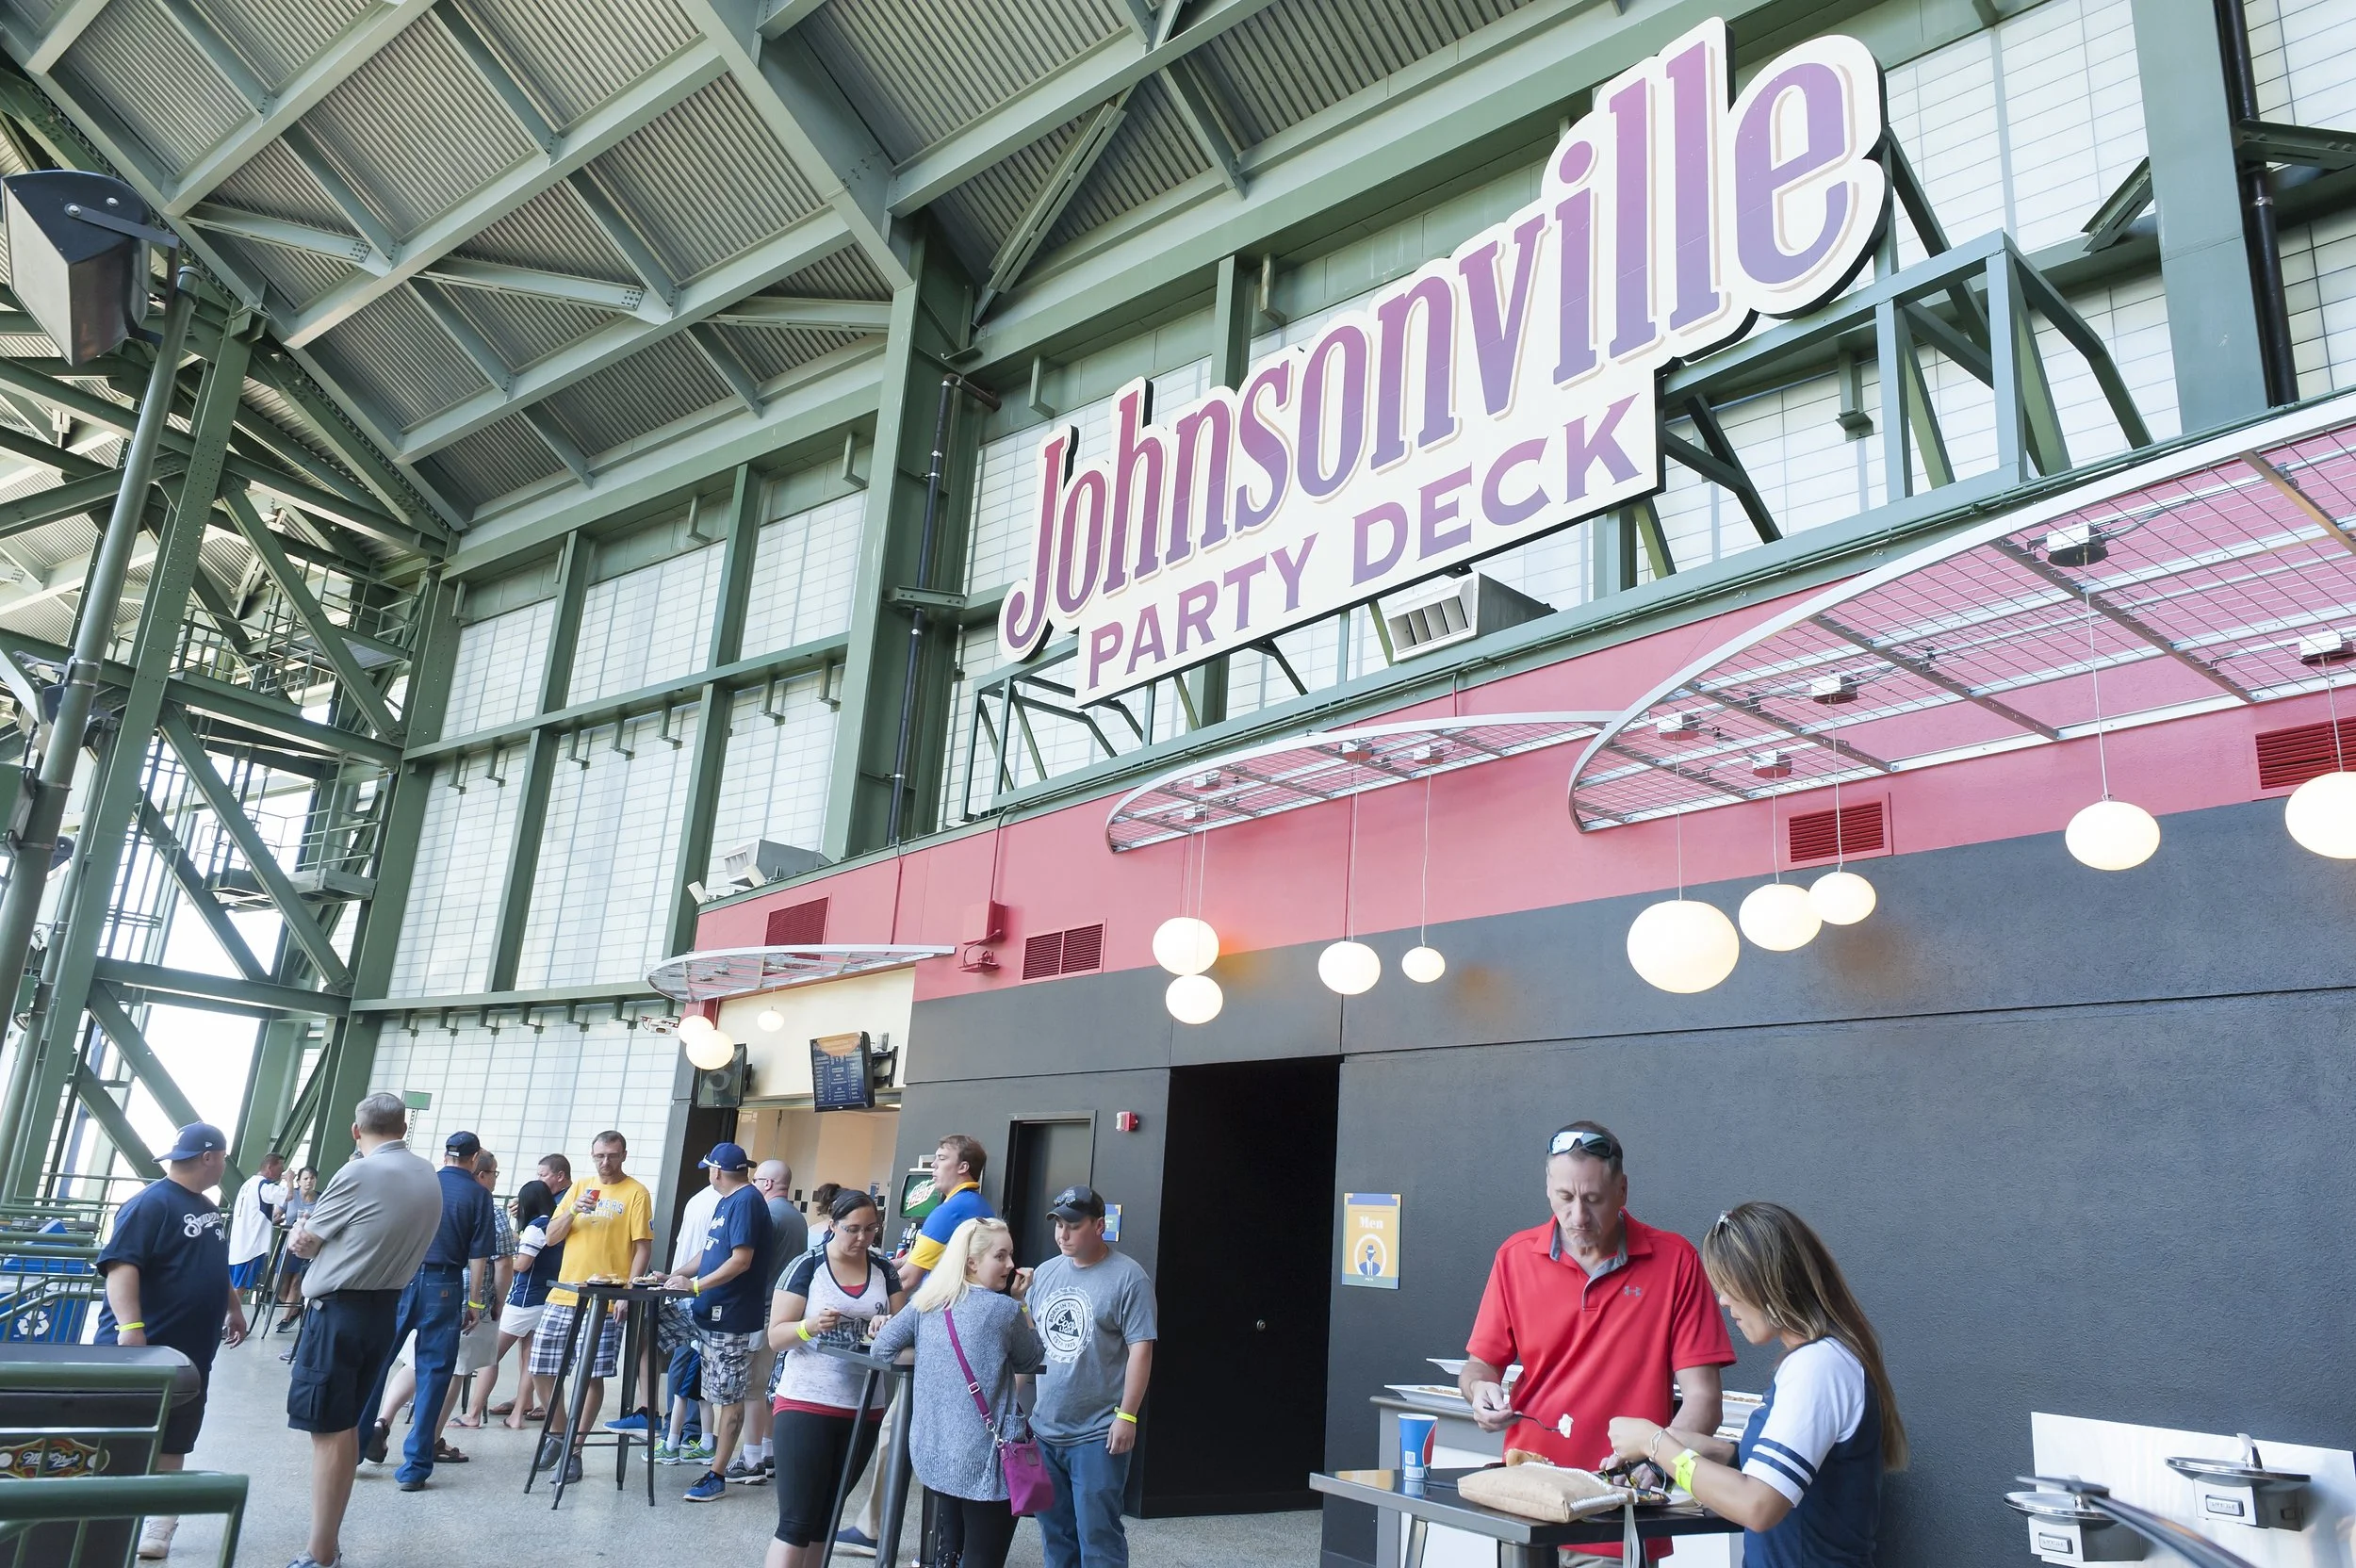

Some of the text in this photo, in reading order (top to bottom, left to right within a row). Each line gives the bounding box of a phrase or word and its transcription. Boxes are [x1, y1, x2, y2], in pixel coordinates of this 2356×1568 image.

[1006, 41, 1856, 650] Johnsonville
[1086, 392, 1643, 691] PARTY DECK
[1359, 1217, 1383, 1230] Men
